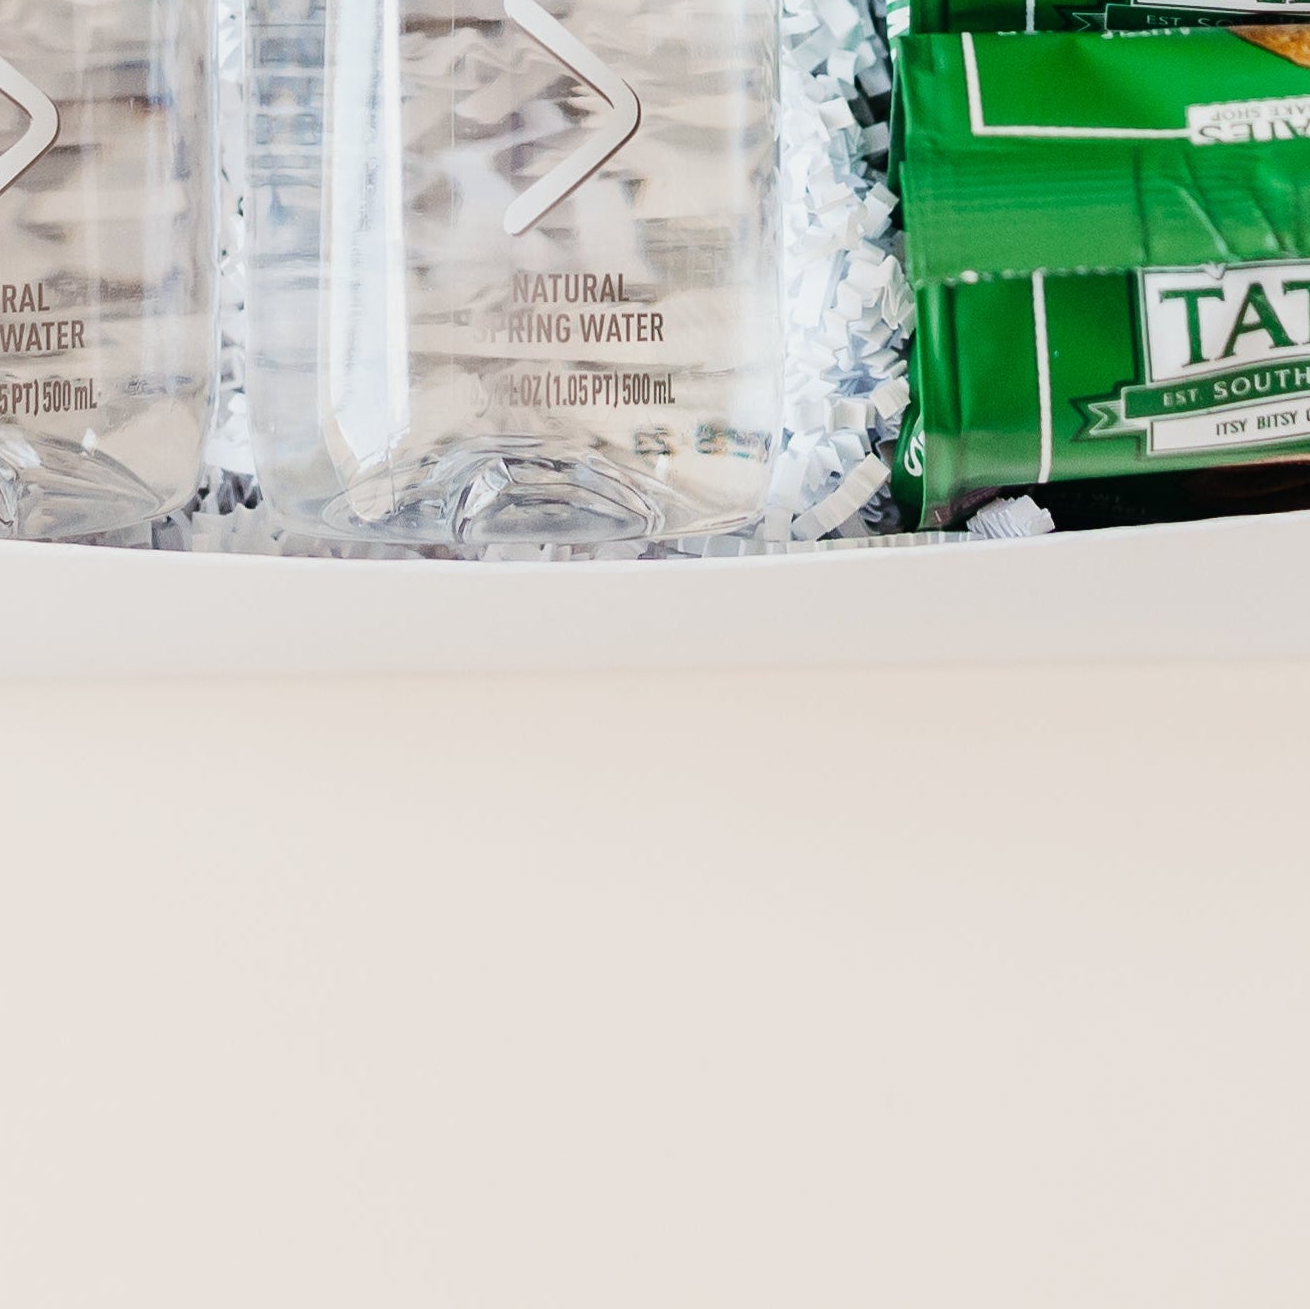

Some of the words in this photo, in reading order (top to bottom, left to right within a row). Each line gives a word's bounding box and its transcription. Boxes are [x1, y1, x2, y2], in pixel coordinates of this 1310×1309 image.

[1211, 106, 1261, 121] SHOP
[513, 273, 630, 303] NATURAL
[0, 319, 85, 352] WATER
[580, 312, 664, 343] WATER
[12, 379, 39, 417] PT)
[43, 380, 72, 412] 500
[74, 378, 97, 409] mL
[546, 371, 588, 408] (1.05
[592, 371, 619, 408] PT)
[622, 374, 651, 405] 500
[653, 373, 676, 404] mL
[1216, 418, 1248, 436] ITSY
[1257, 412, 1298, 431] BITSY
